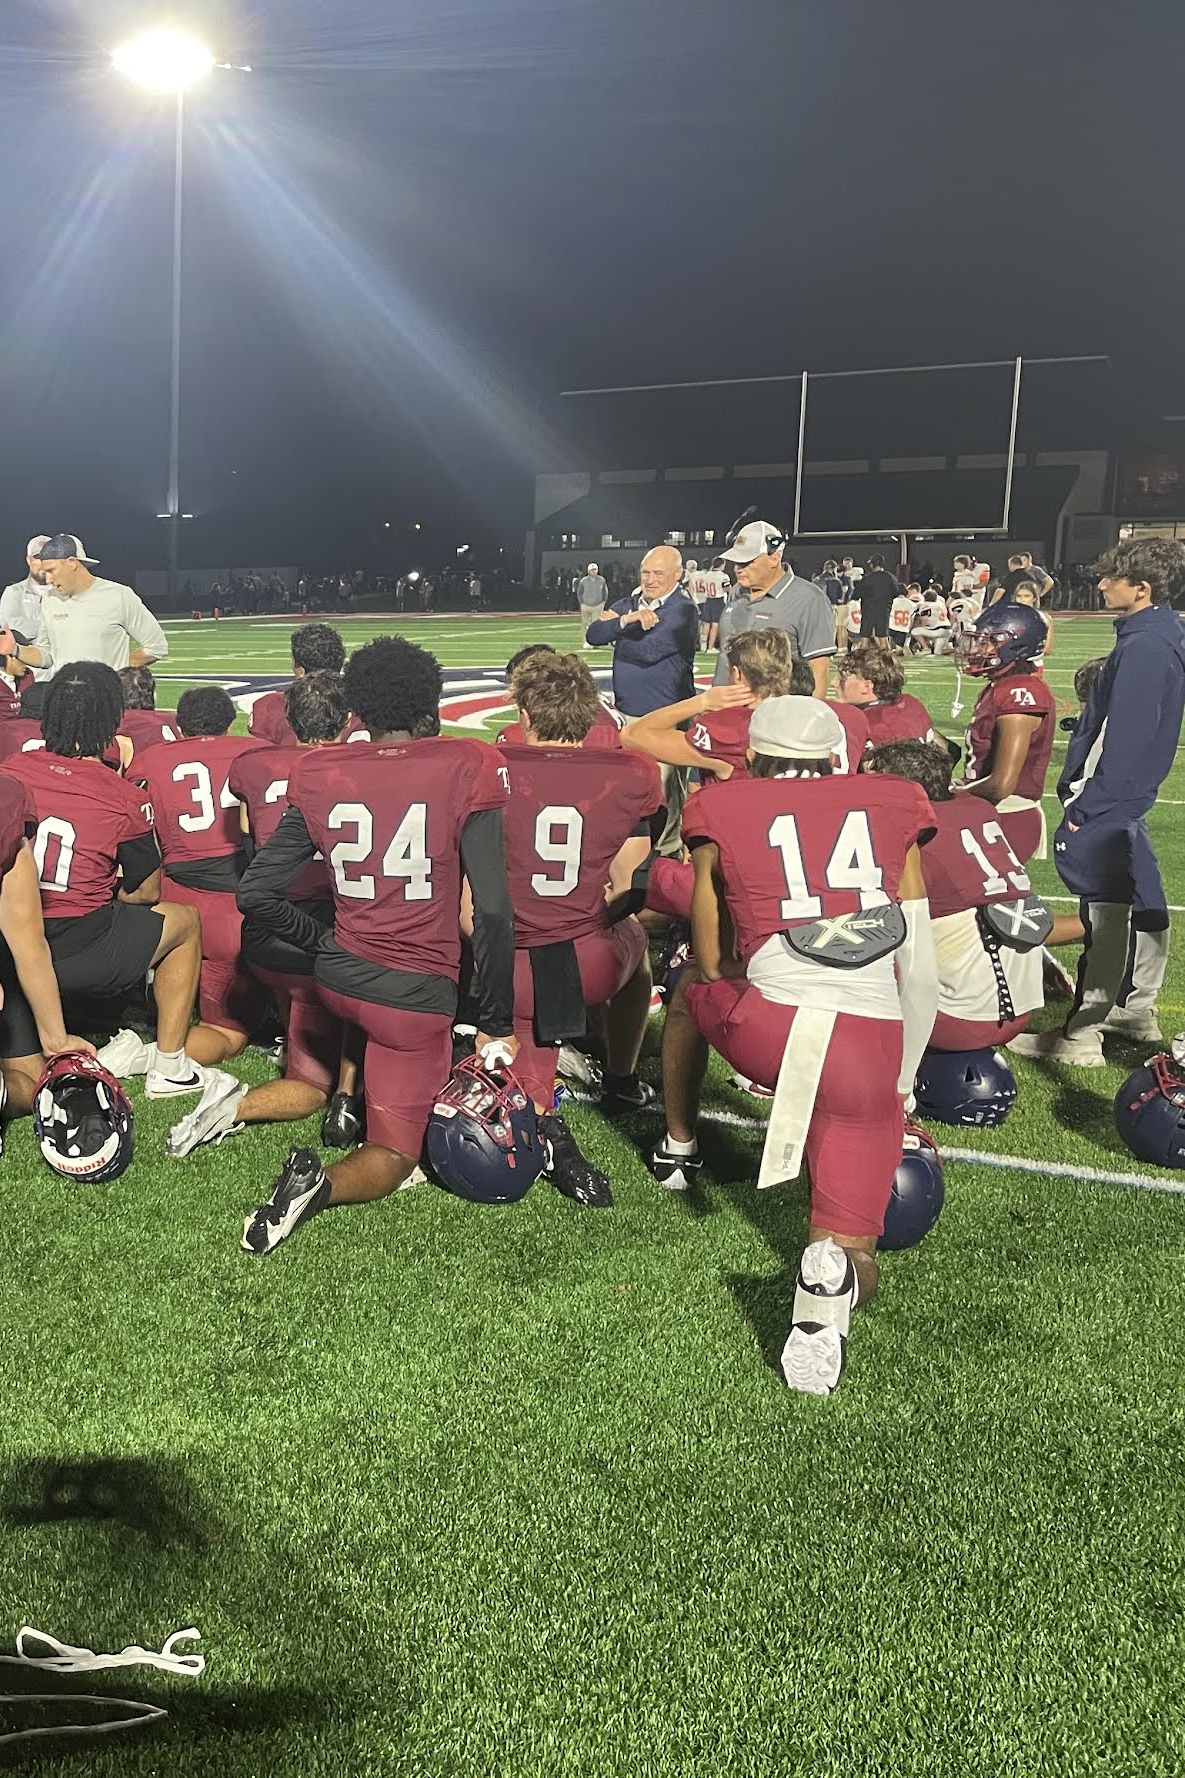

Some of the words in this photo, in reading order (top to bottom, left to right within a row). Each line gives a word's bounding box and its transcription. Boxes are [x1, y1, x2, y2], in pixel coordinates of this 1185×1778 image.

[693, 722, 712, 752] TA
[1010, 687, 1037, 706] TA
[328, 803, 432, 900] 24
[531, 806, 583, 897] 9
[768, 810, 893, 921] 14
[960, 820, 1031, 896] 13
